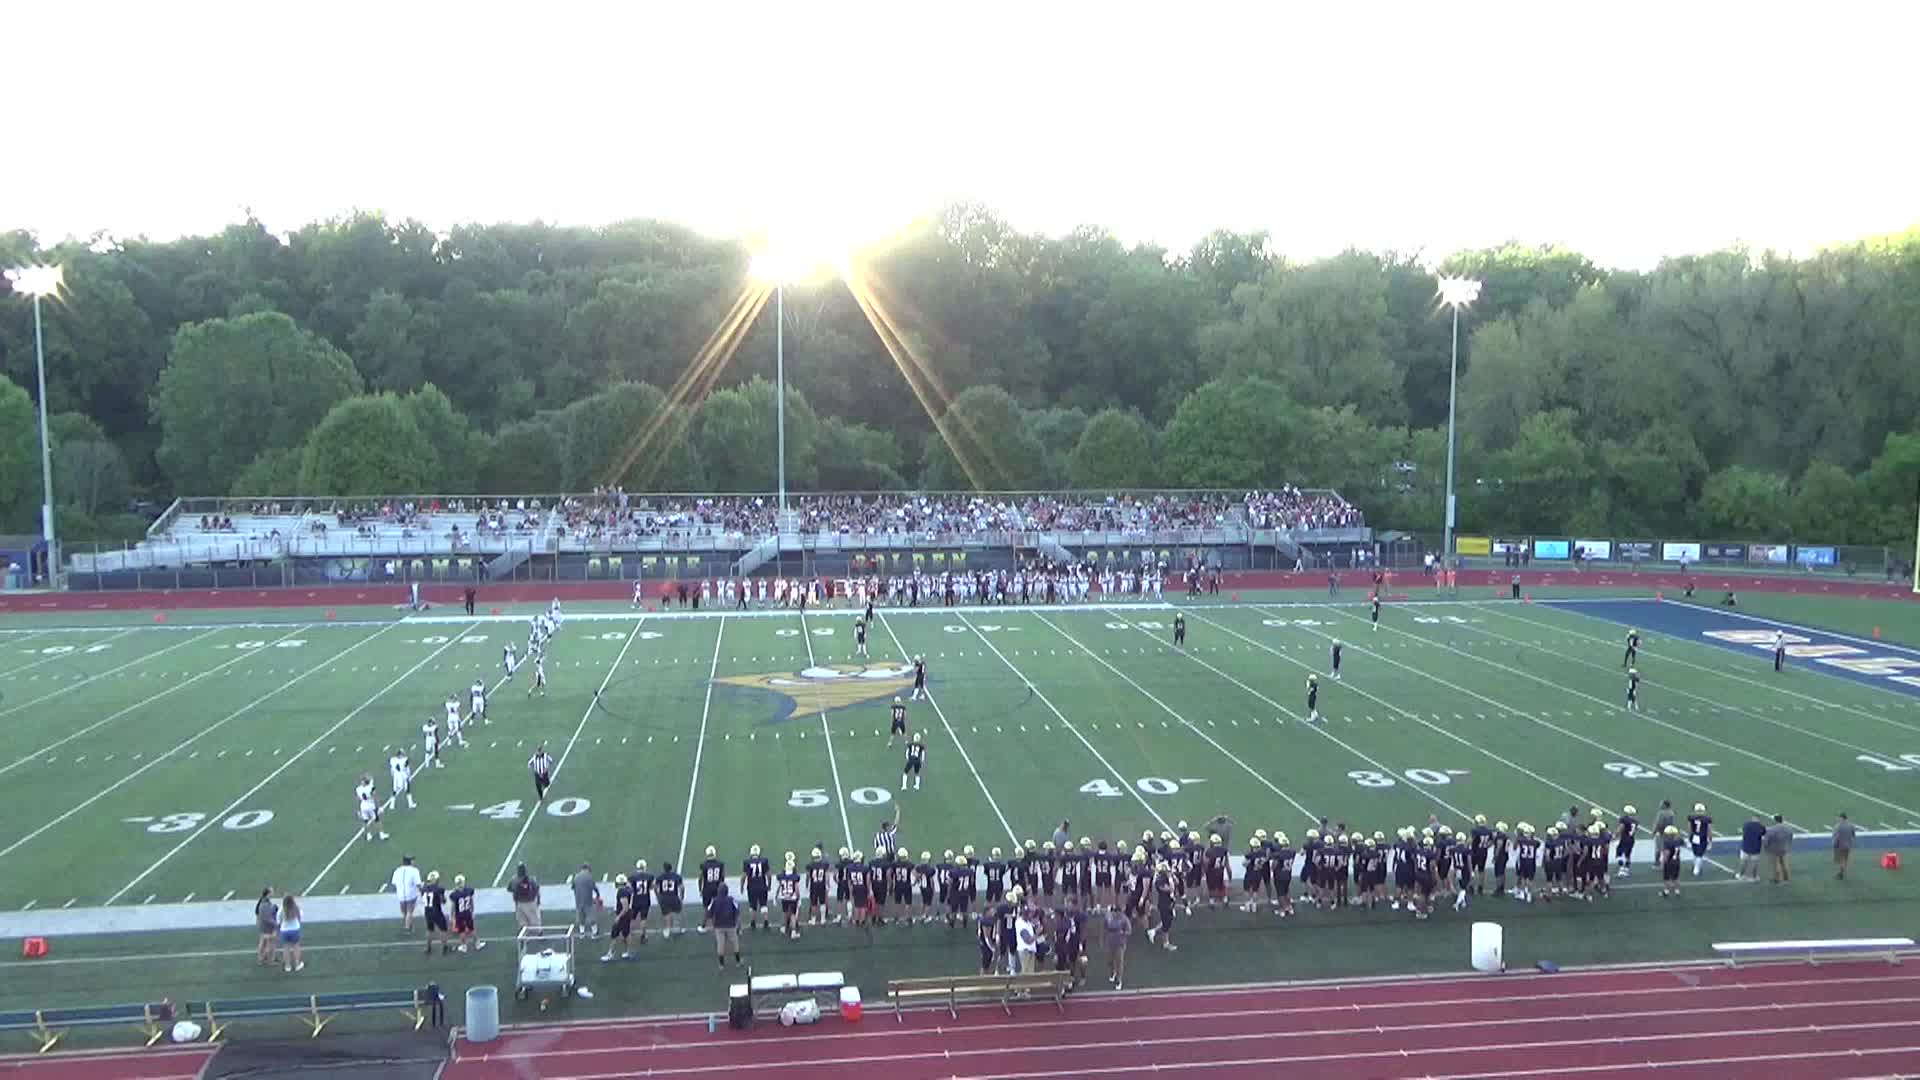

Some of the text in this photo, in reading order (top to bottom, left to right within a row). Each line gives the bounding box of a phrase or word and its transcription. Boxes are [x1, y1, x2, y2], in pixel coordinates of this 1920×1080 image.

[1347, 768, 1451, 787] 30
[1603, 761, 1710, 779] 20
[1079, 777, 1179, 797] 40
[787, 787, 892, 807] 50
[479, 798, 591, 819] 40
[146, 810, 275, 833] 30
[1521, 844, 1534, 859] 33
[750, 863, 763, 878] 71
